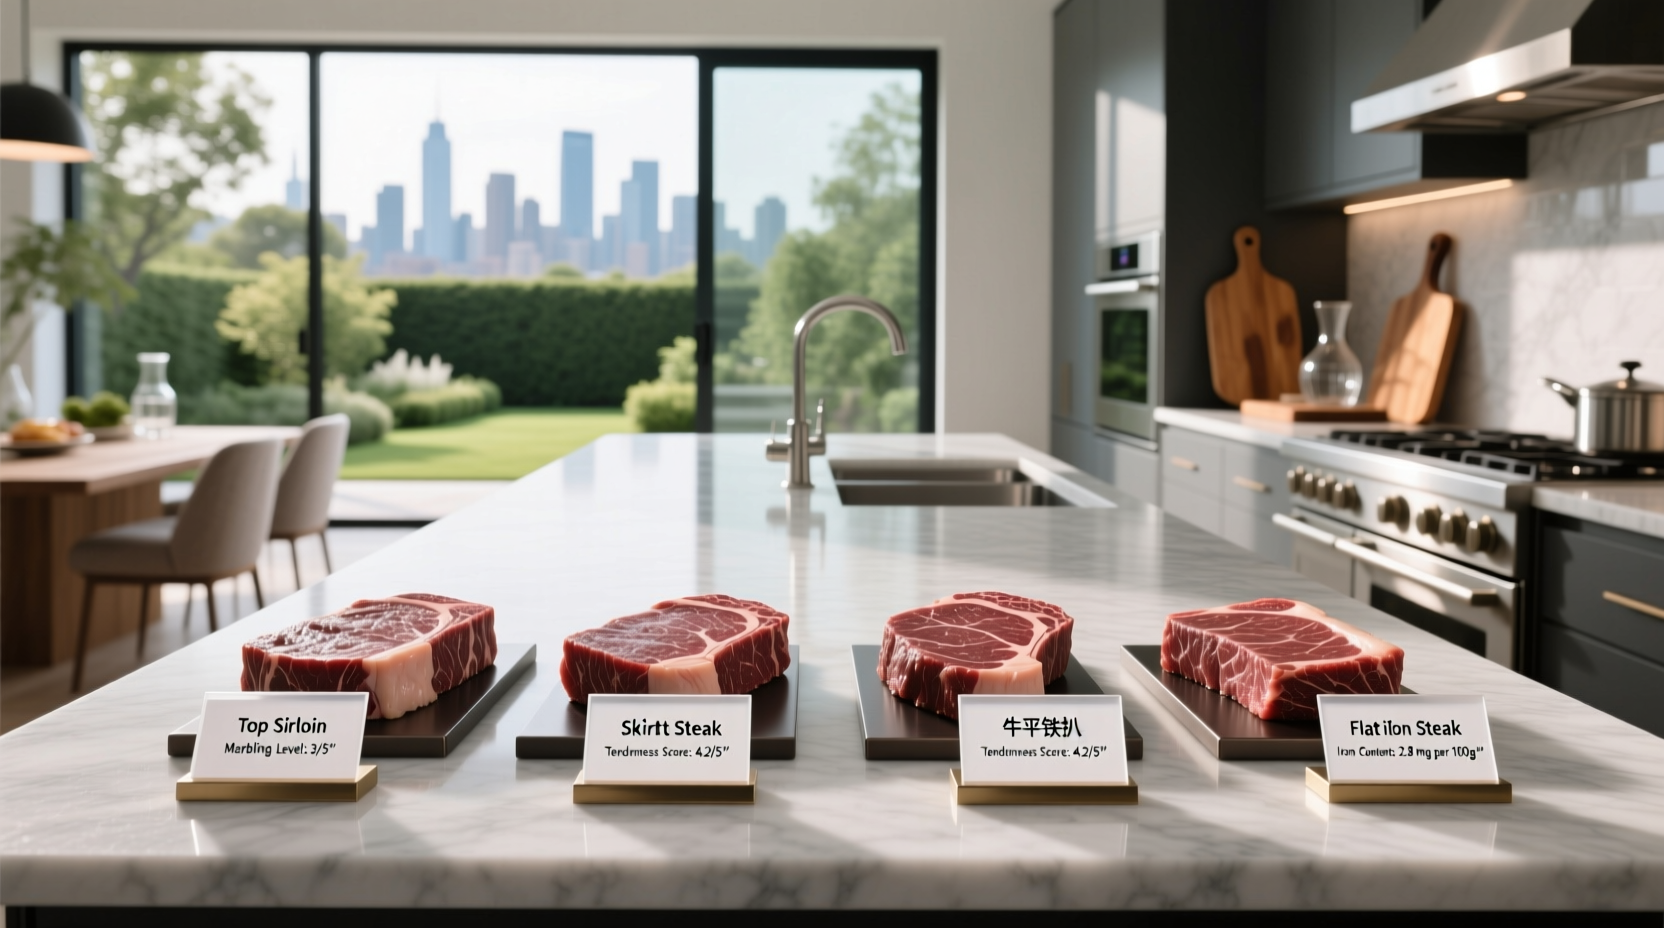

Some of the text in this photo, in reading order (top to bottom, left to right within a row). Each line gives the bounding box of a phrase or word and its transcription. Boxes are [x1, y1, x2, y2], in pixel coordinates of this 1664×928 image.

[238, 717, 327, 737] Top Sirloin
[675, 720, 722, 736] Steak
[1003, 716, 1082, 738] 牛平铁扒
[1416, 720, 1462, 736] Steak
[224, 743, 272, 757] Marbling
[276, 743, 308, 755] Level:
[1416, 748, 1431, 760] mg
